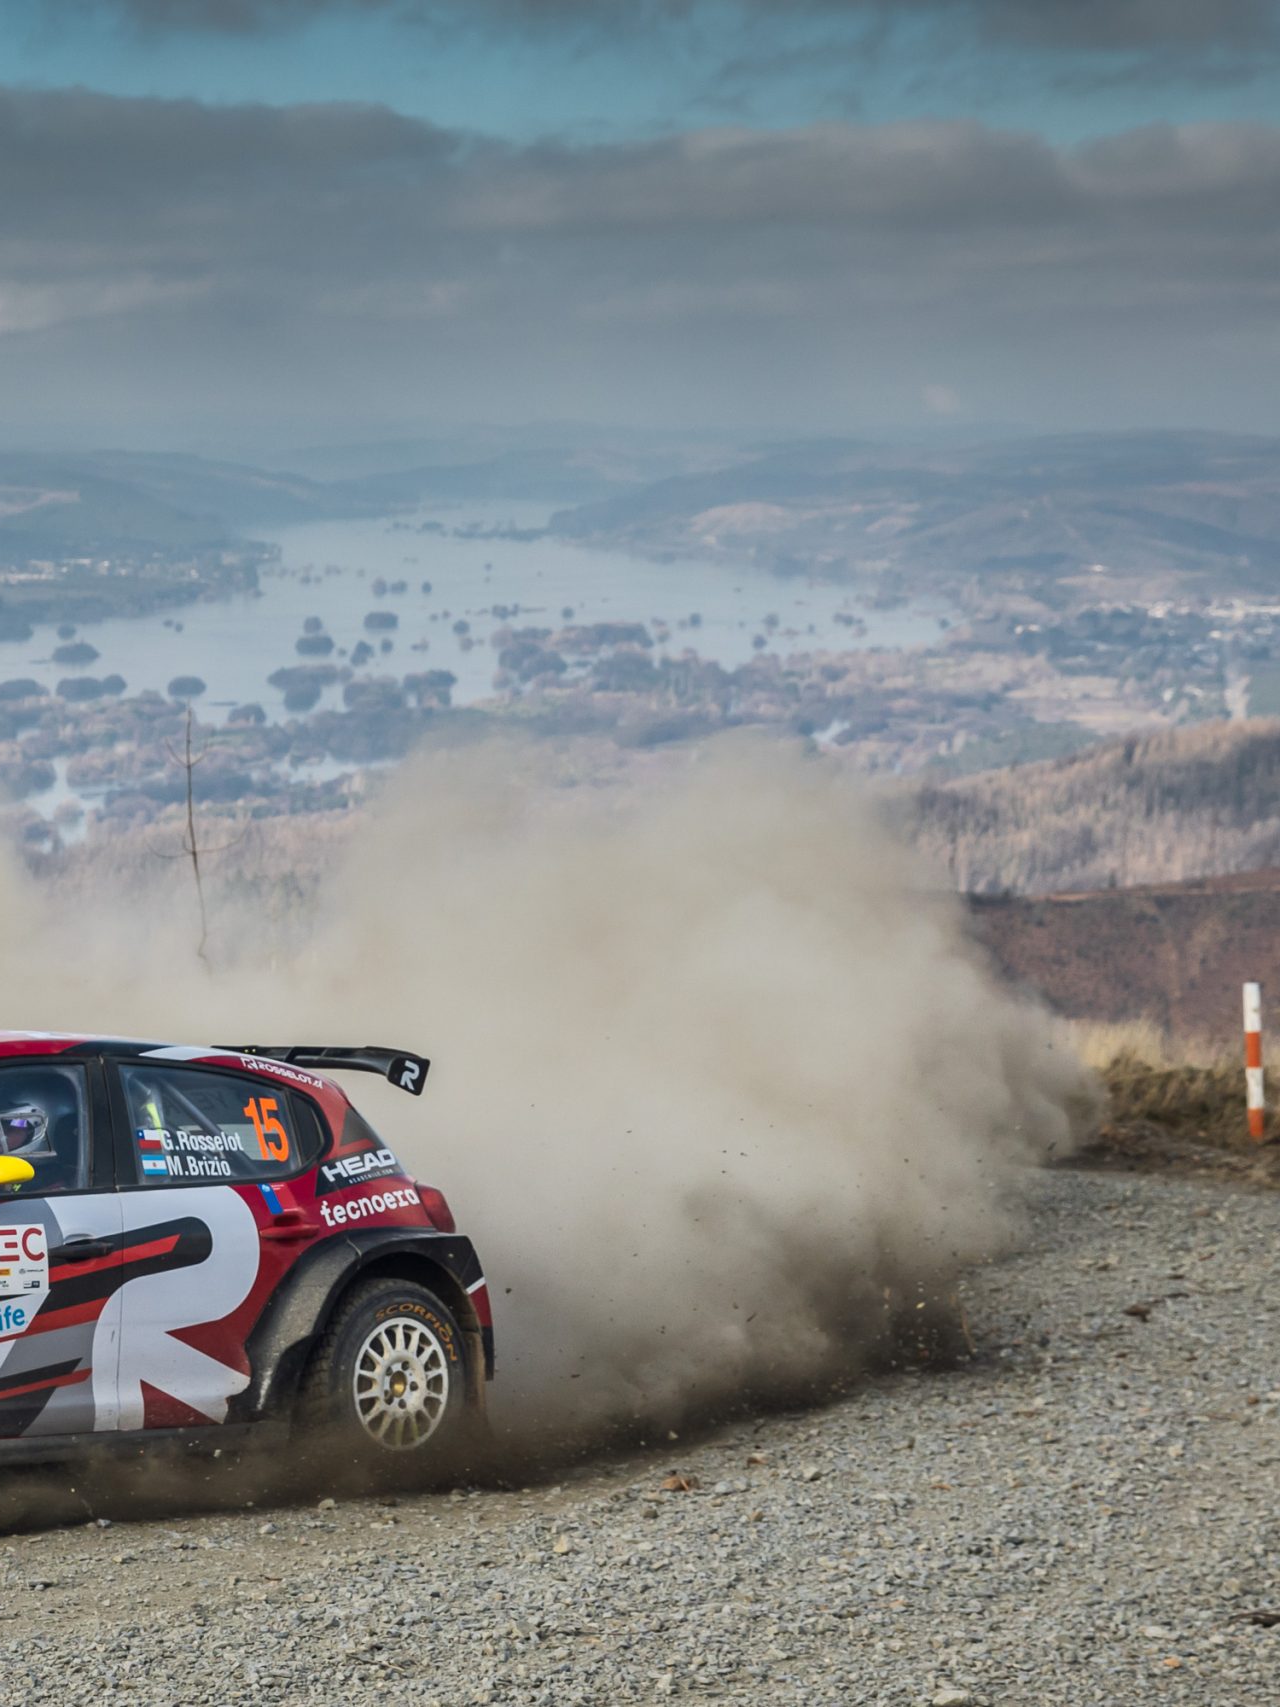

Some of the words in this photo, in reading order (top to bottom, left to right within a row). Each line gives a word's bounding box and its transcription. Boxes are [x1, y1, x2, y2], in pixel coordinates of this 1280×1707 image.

[400, 1060, 420, 1091] R
[162, 1130, 244, 1152] G.Rosselot
[243, 1097, 290, 1163] 15
[169, 1155, 232, 1177] M.Brizio
[321, 1148, 397, 1183] HEAD
[320, 1188, 421, 1227] tecnoera
[375, 1303, 458, 1361] SCORPION
